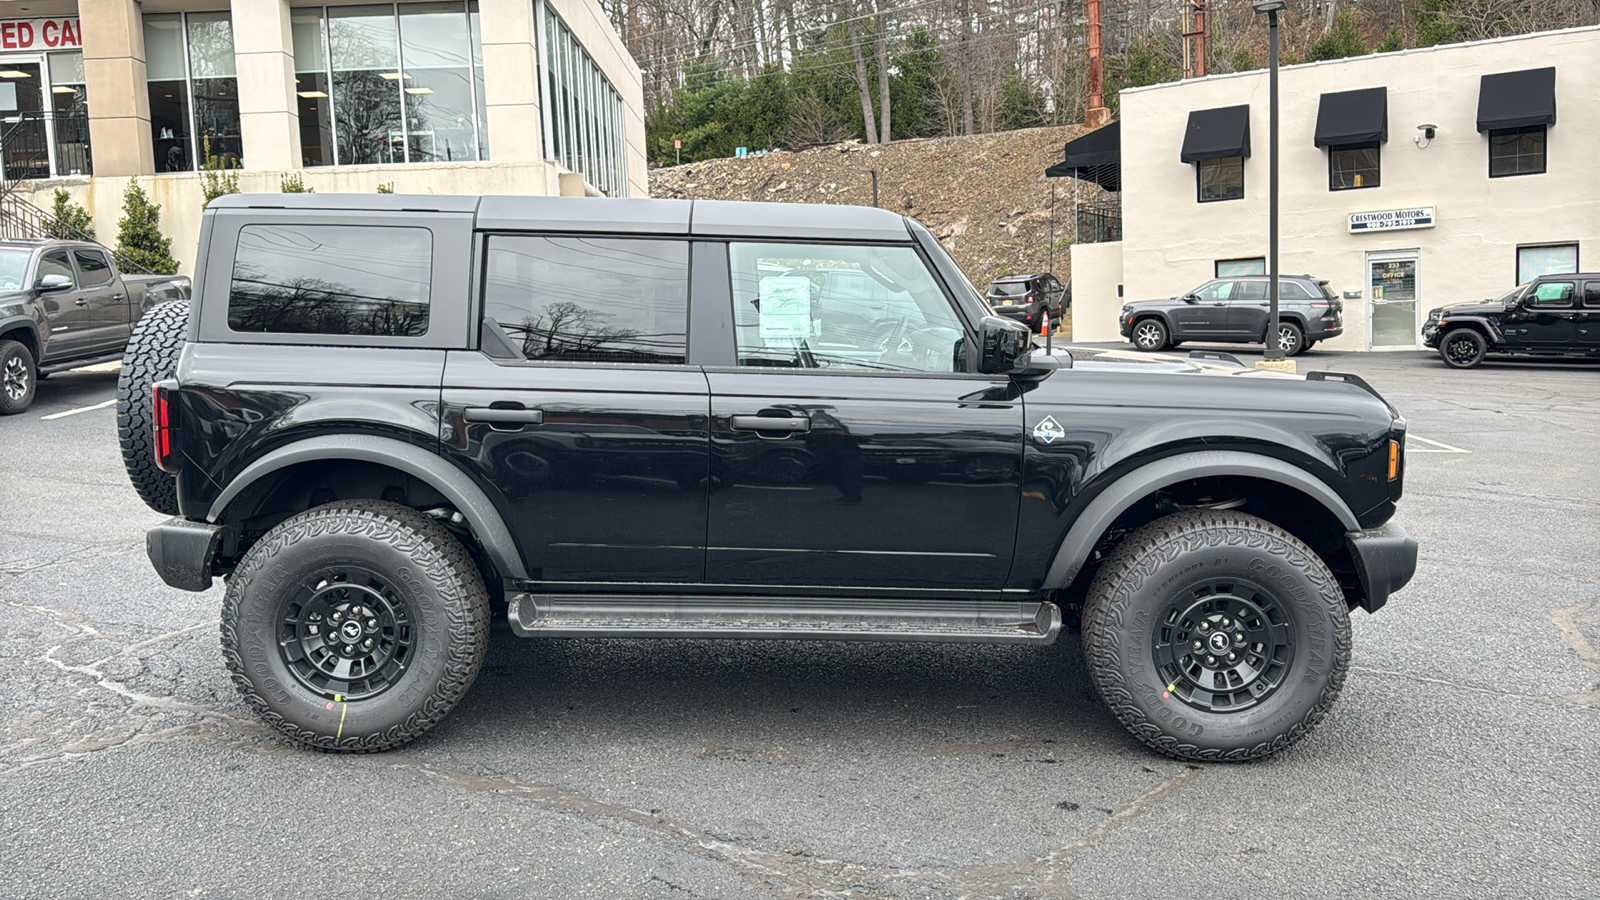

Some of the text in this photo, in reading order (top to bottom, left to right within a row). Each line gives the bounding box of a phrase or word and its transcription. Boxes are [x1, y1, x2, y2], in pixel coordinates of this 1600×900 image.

[0, 22, 34, 48] ED
[1350, 212, 1393, 223] CRESTWOOD
[1395, 210, 1424, 219] MOTORS
[245, 563, 290, 707] GOODYEAR
[397, 566, 442, 707] GOODYEAR
[1125, 609, 1206, 739] GOODYEAR
[1249, 557, 1327, 687] GOODYEAR
